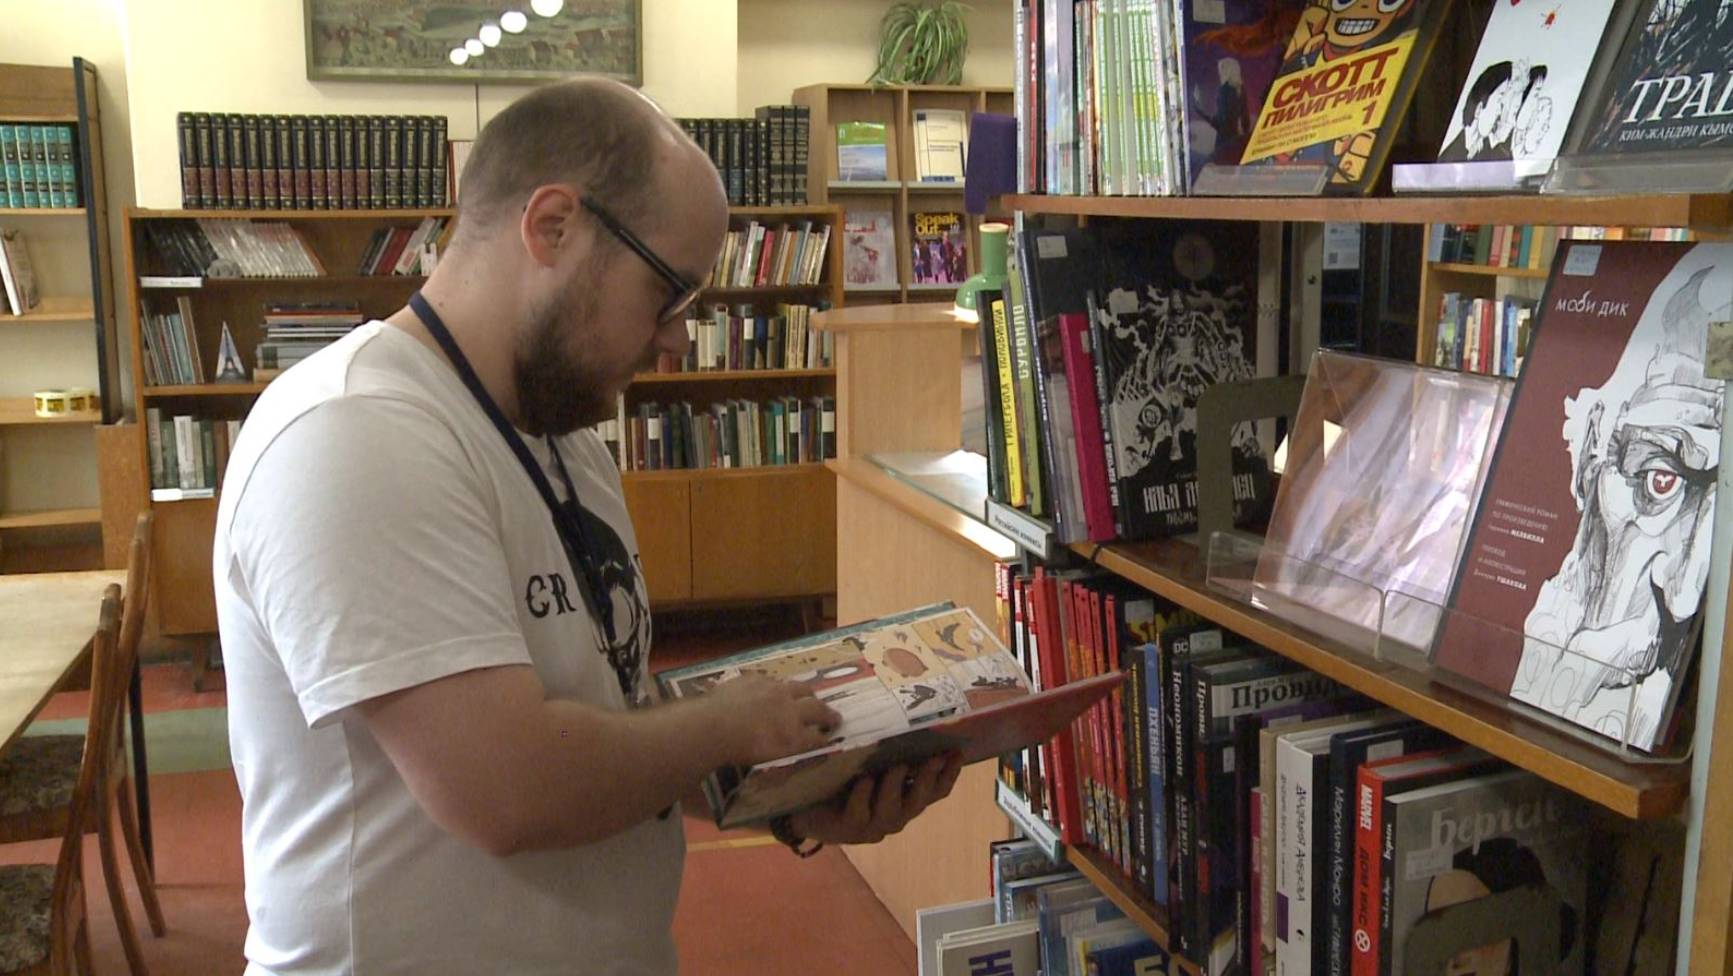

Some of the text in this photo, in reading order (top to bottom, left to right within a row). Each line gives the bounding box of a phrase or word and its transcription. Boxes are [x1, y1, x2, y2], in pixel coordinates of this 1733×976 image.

[1261, 78, 1387, 129] ПИЛИГРИМ
[1272, 47, 1400, 109] СКОТТ
[1362, 101, 1377, 126] 1
[1173, 642, 1189, 654] DC
[1147, 706, 1161, 775] ПХЕНЬЯН
[1173, 671, 1184, 777] Неономикон
[1360, 784, 1374, 831] MARVEL
